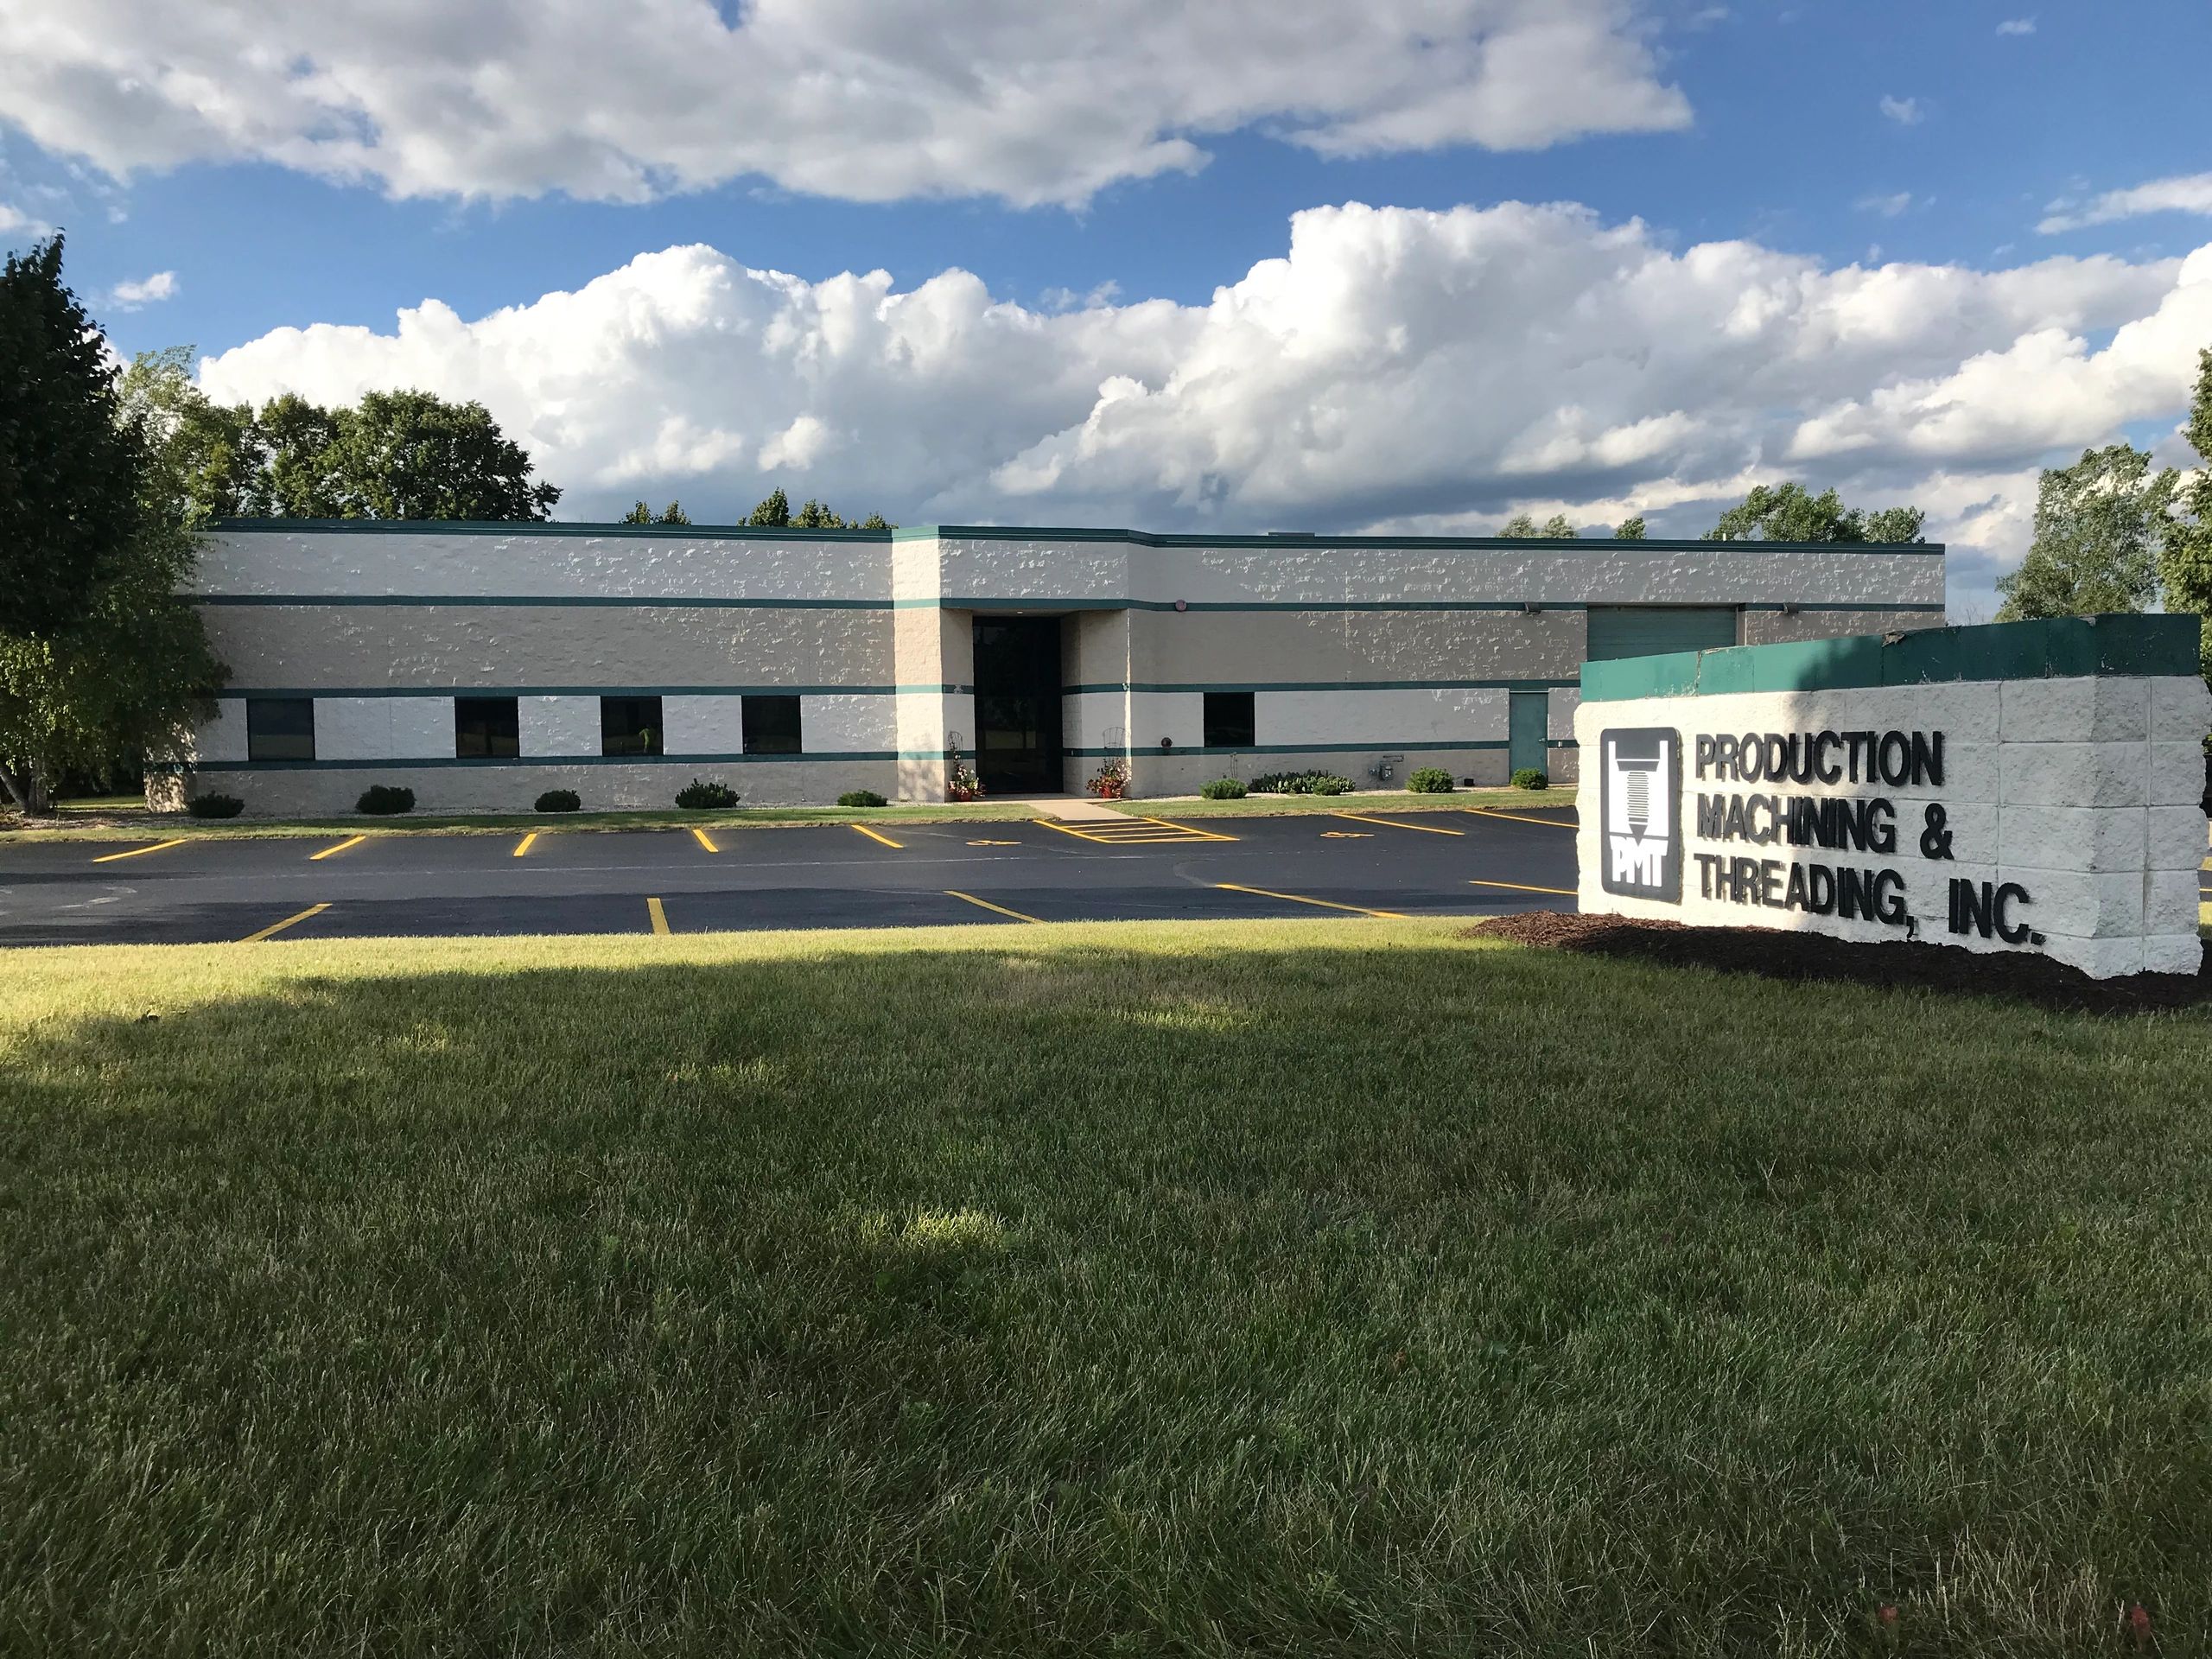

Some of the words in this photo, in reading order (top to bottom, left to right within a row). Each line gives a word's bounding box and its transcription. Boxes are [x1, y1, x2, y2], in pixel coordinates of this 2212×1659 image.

[1695, 730, 1943, 785] PRODUCTION
[1696, 793, 1896, 854] MACHINING
[1920, 803, 1953, 860] &
[1609, 835, 1669, 887] PMT
[1694, 853, 1915, 938] THREADING,
[1948, 878, 2046, 944] INC.
